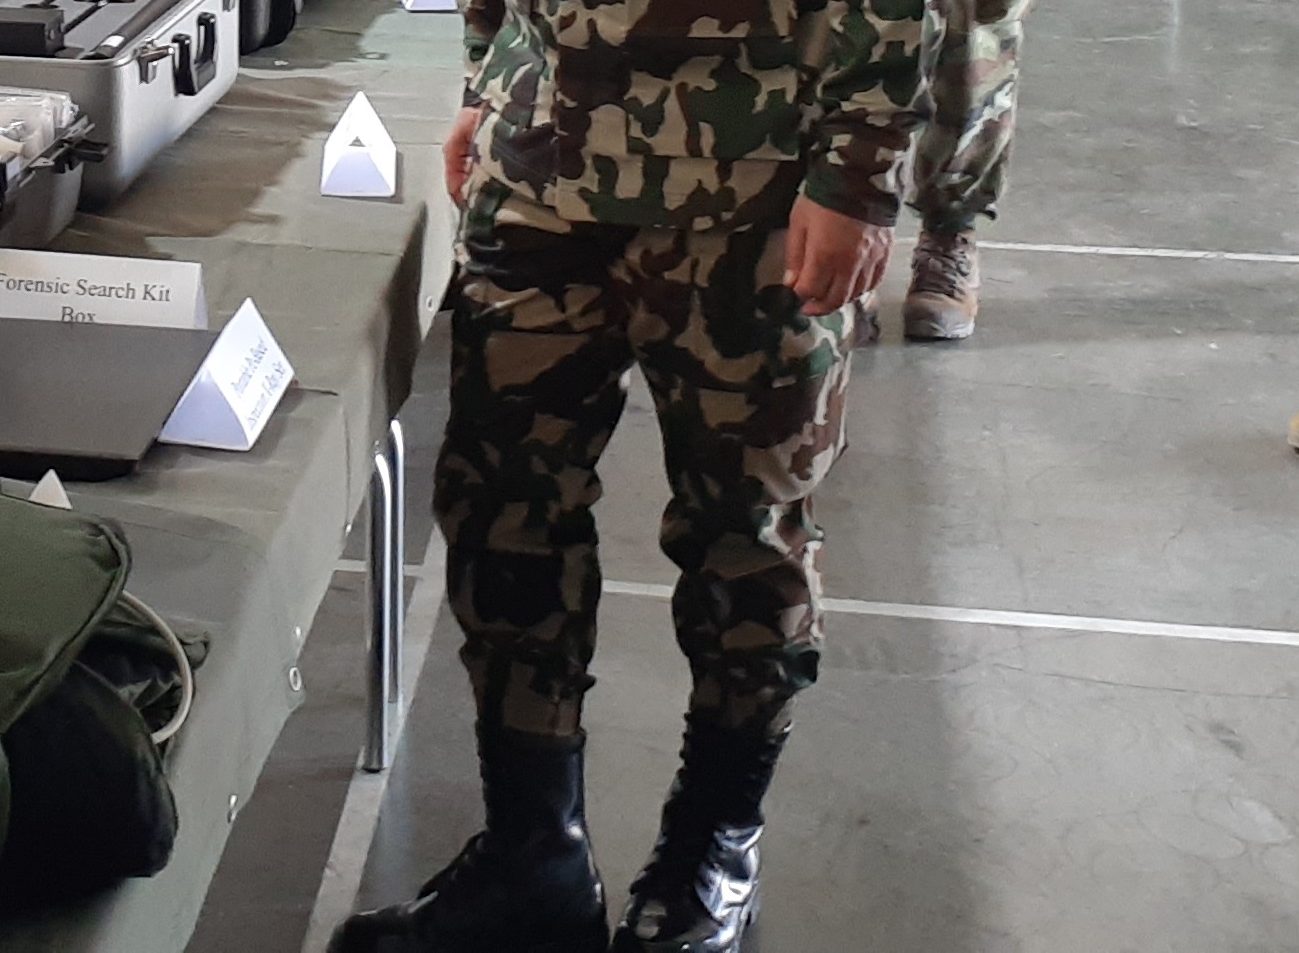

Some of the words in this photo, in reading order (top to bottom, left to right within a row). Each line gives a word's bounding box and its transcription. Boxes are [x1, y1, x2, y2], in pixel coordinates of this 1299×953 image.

[75, 279, 136, 300] Search
[142, 284, 171, 302] Kit
[61, 306, 96, 323] Box
